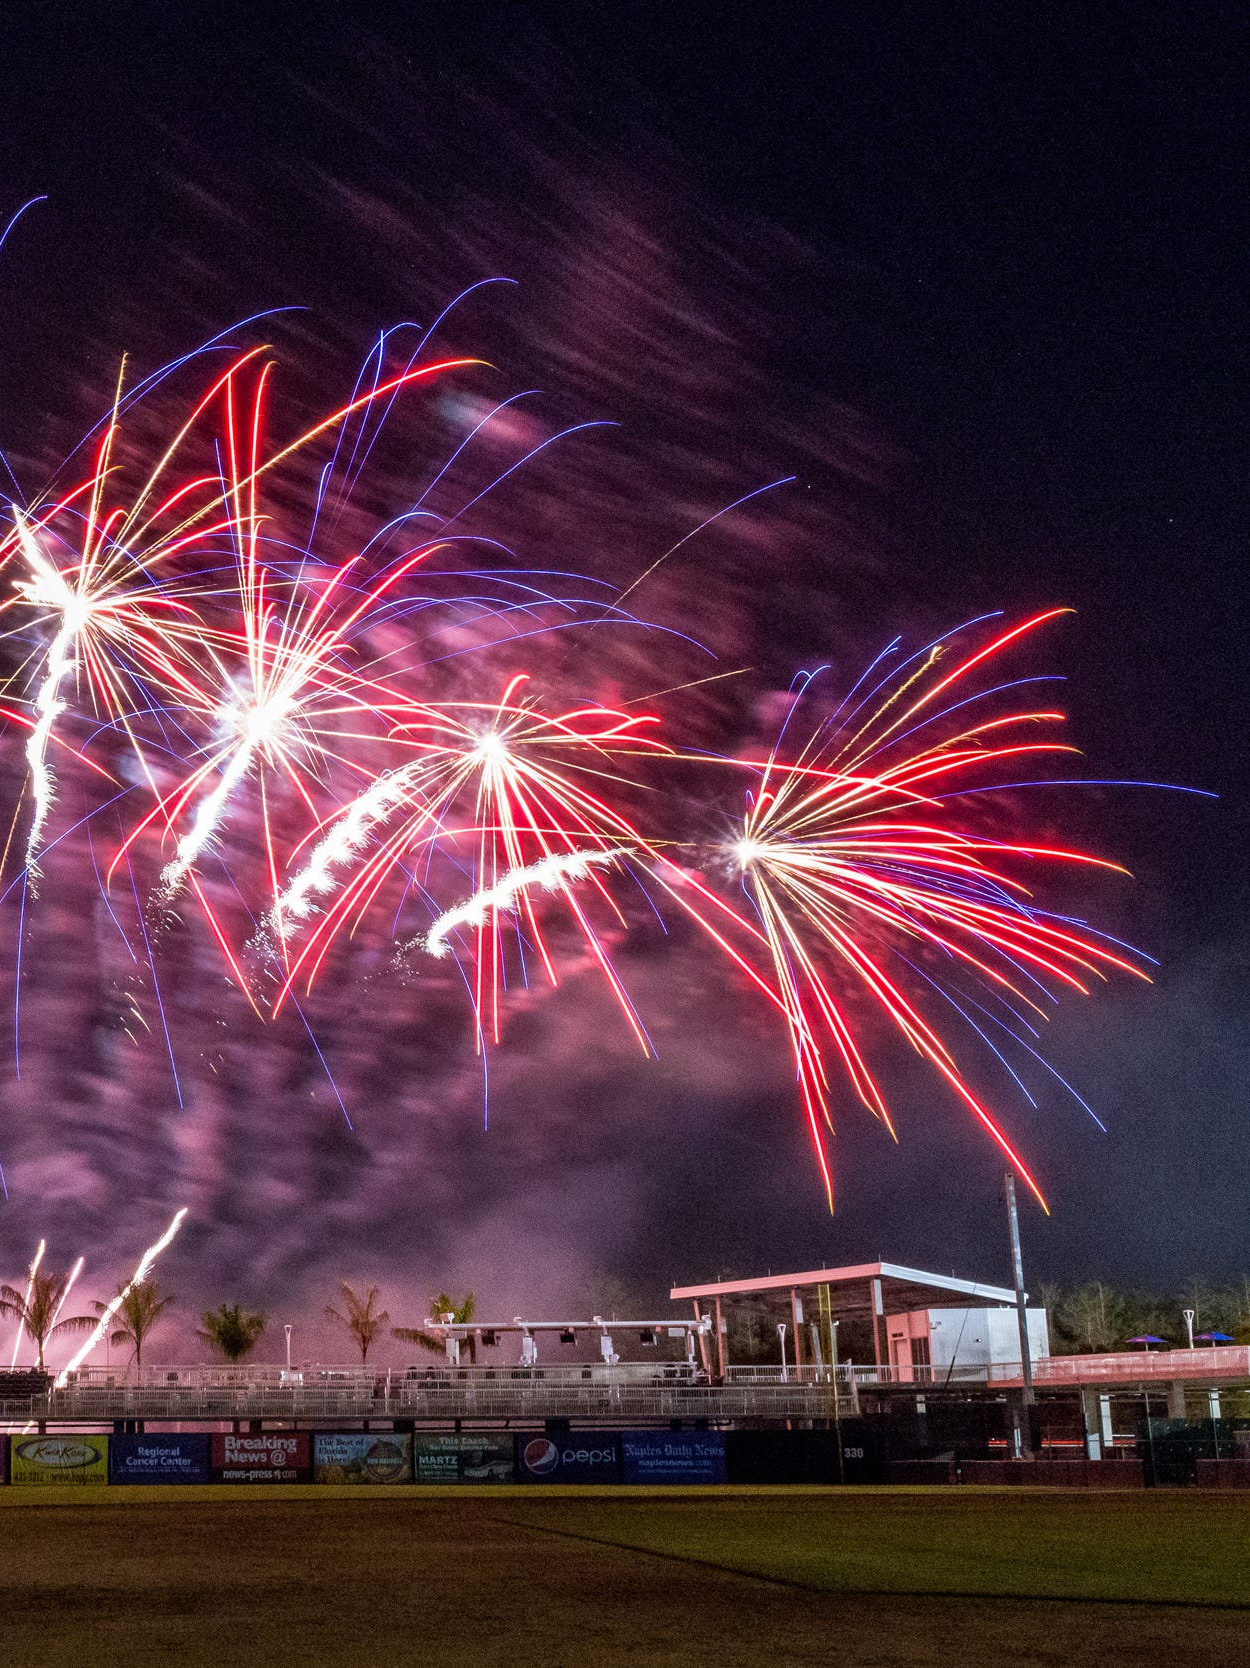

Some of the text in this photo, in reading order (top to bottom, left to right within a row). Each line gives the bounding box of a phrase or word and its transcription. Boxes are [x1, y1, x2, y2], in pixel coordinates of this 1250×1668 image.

[224, 1435, 298, 1453] Breaking
[319, 1438, 364, 1446] The Best of
[138, 1446, 180, 1457] Regional
[319, 1447, 348, 1455] Florida
[625, 1443, 725, 1458] Naples Daily News
[844, 1448, 864, 1458] 330
[125, 1456, 192, 1466] Cancer Center
[224, 1450, 286, 1466] News @
[418, 1455, 458, 1464] MARTZ
[562, 1446, 616, 1466] pepsi
